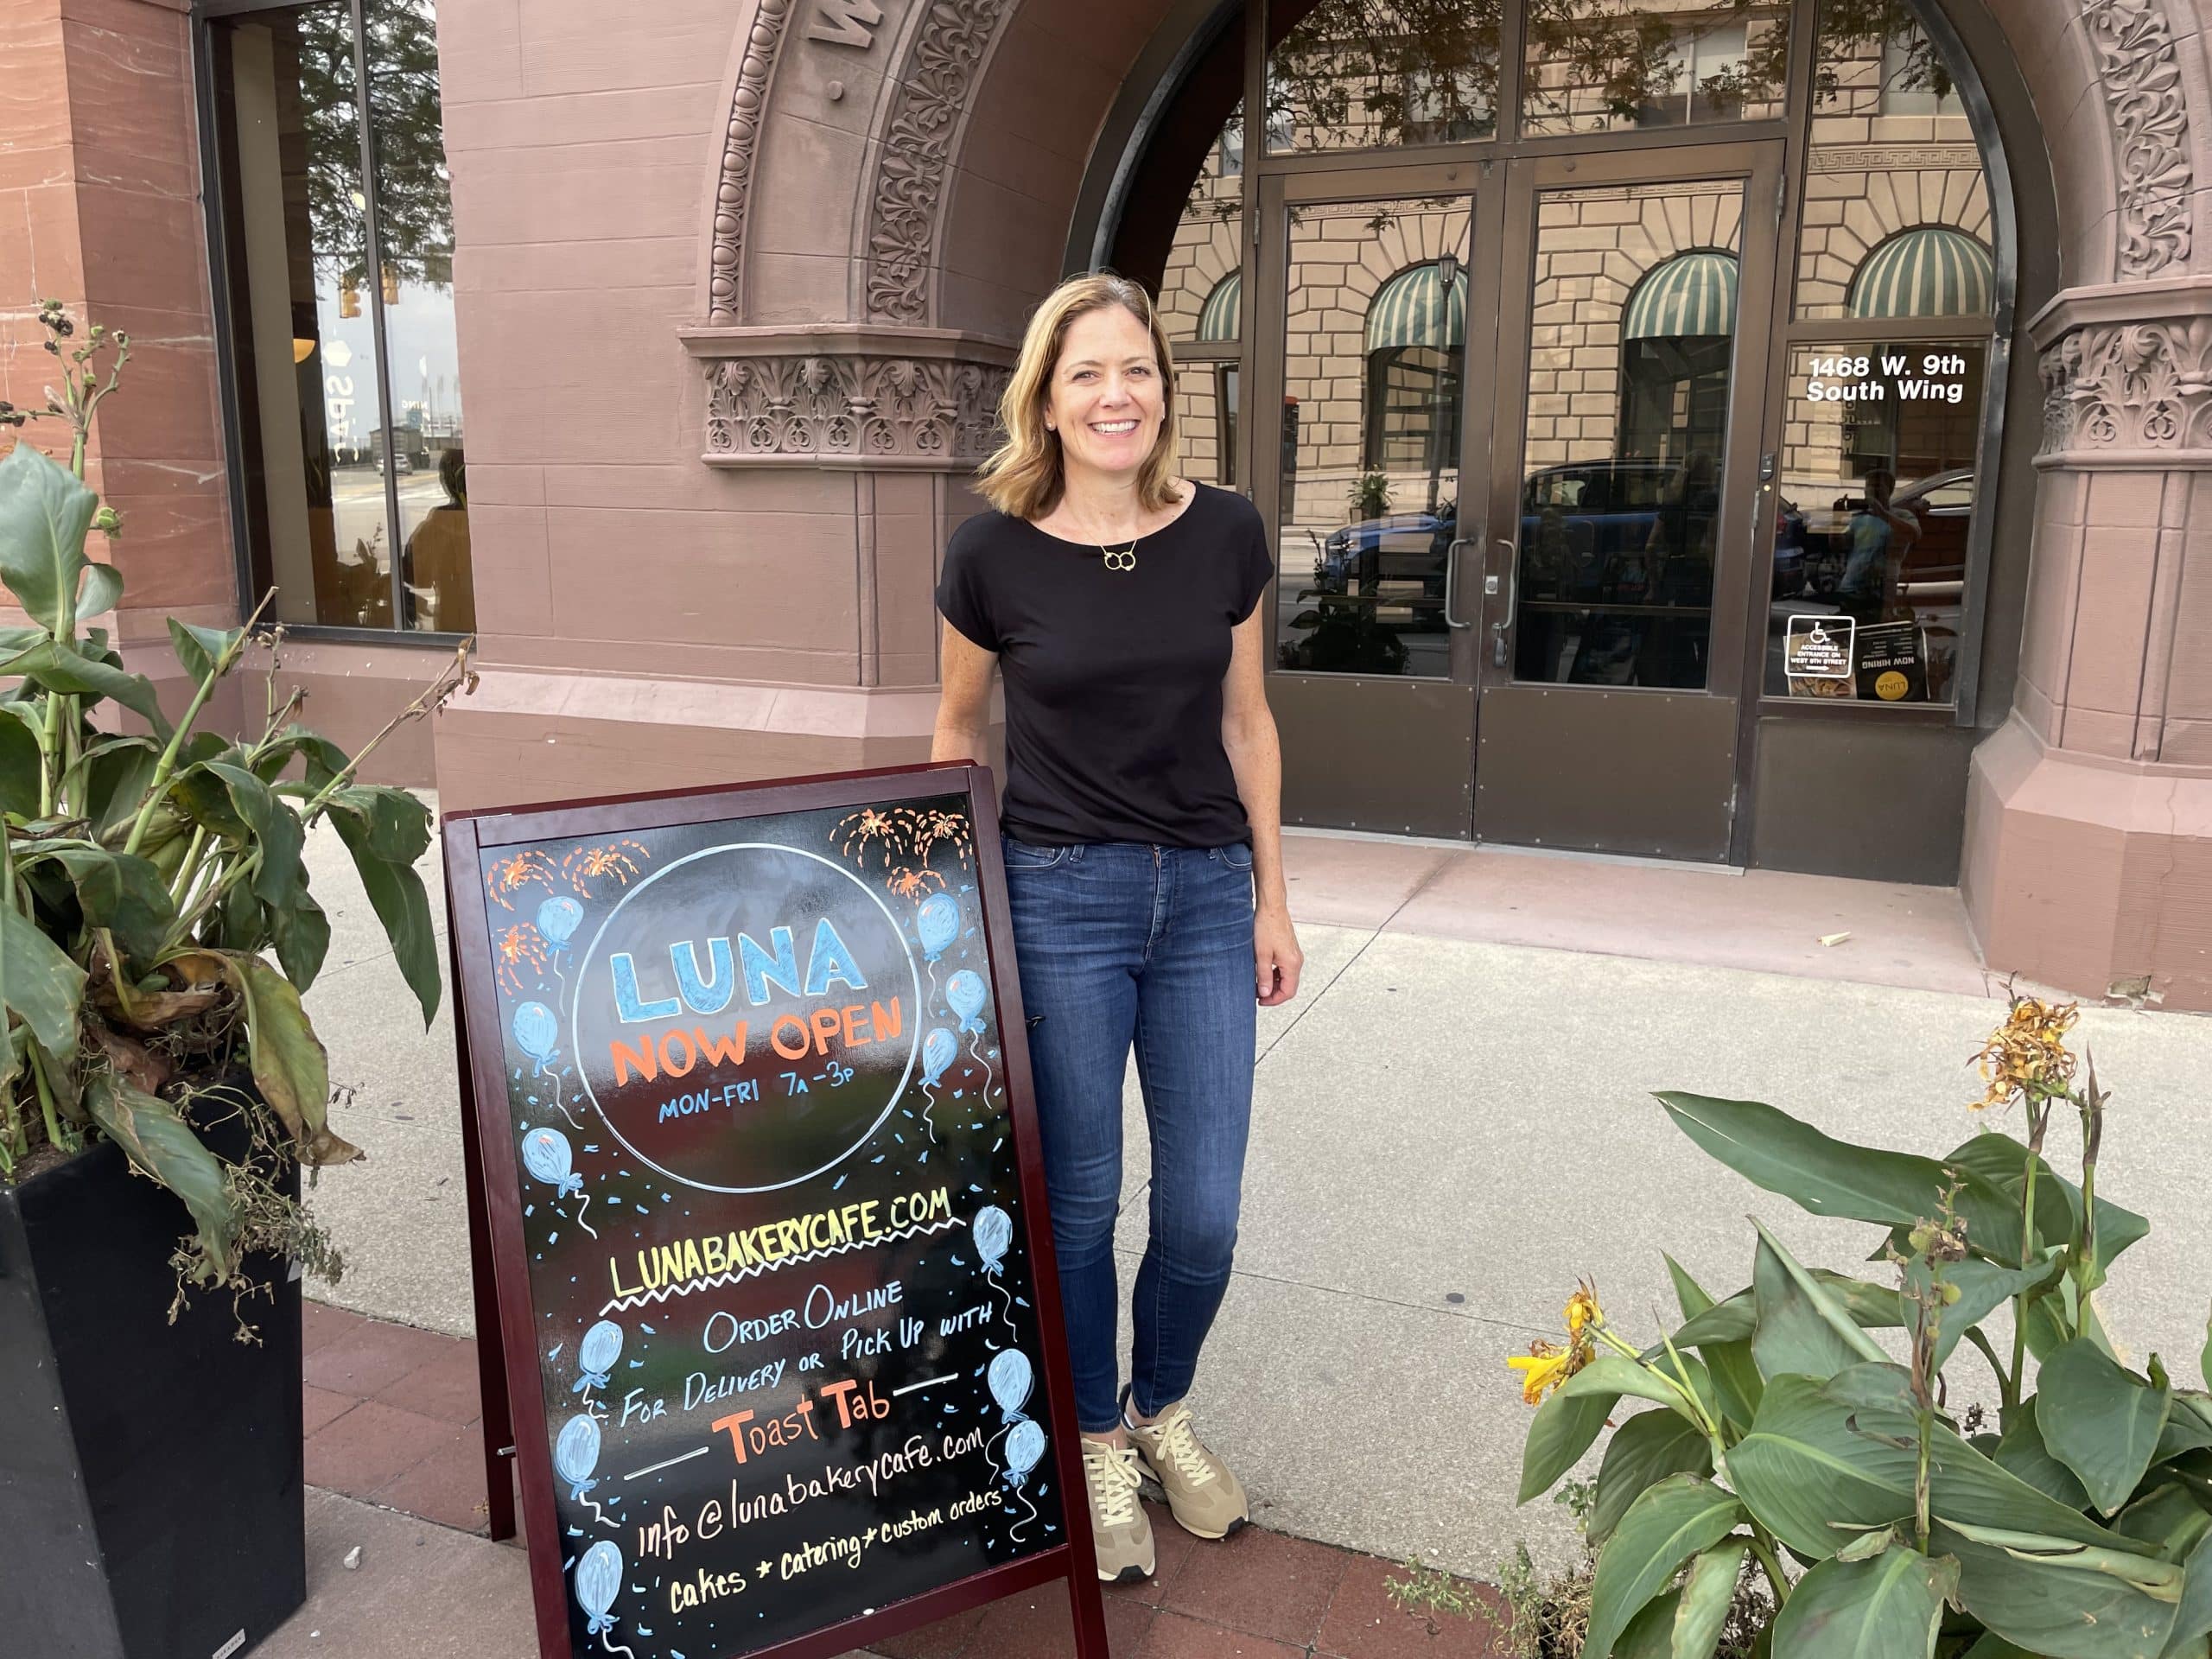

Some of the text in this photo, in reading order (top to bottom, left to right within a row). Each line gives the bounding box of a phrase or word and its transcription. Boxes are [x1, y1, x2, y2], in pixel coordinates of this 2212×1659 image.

[1807, 379, 1963, 404] South Wing
[1808, 354, 1966, 378] 1468 W. 9th
[1862, 657, 1915, 670] NOW HIRING
[1878, 681, 1906, 692] LUNA
[609, 918, 868, 1024] LUNA
[609, 996, 902, 1087] NOW OPEN
[658, 1078, 760, 1123] MON-FRI
[610, 1186, 951, 1297] LUNABAKERYCAFE.COM
[702, 1281, 903, 1354] ORDER ONLINE
[620, 1388, 667, 1428] FOR
[683, 1358, 785, 1411] DELIVERY
[798, 1352, 824, 1372] OR
[940, 1301, 993, 1337] WITH
[711, 1378, 891, 1465] Toast Tab
[950, 1490, 1002, 1521] orders
